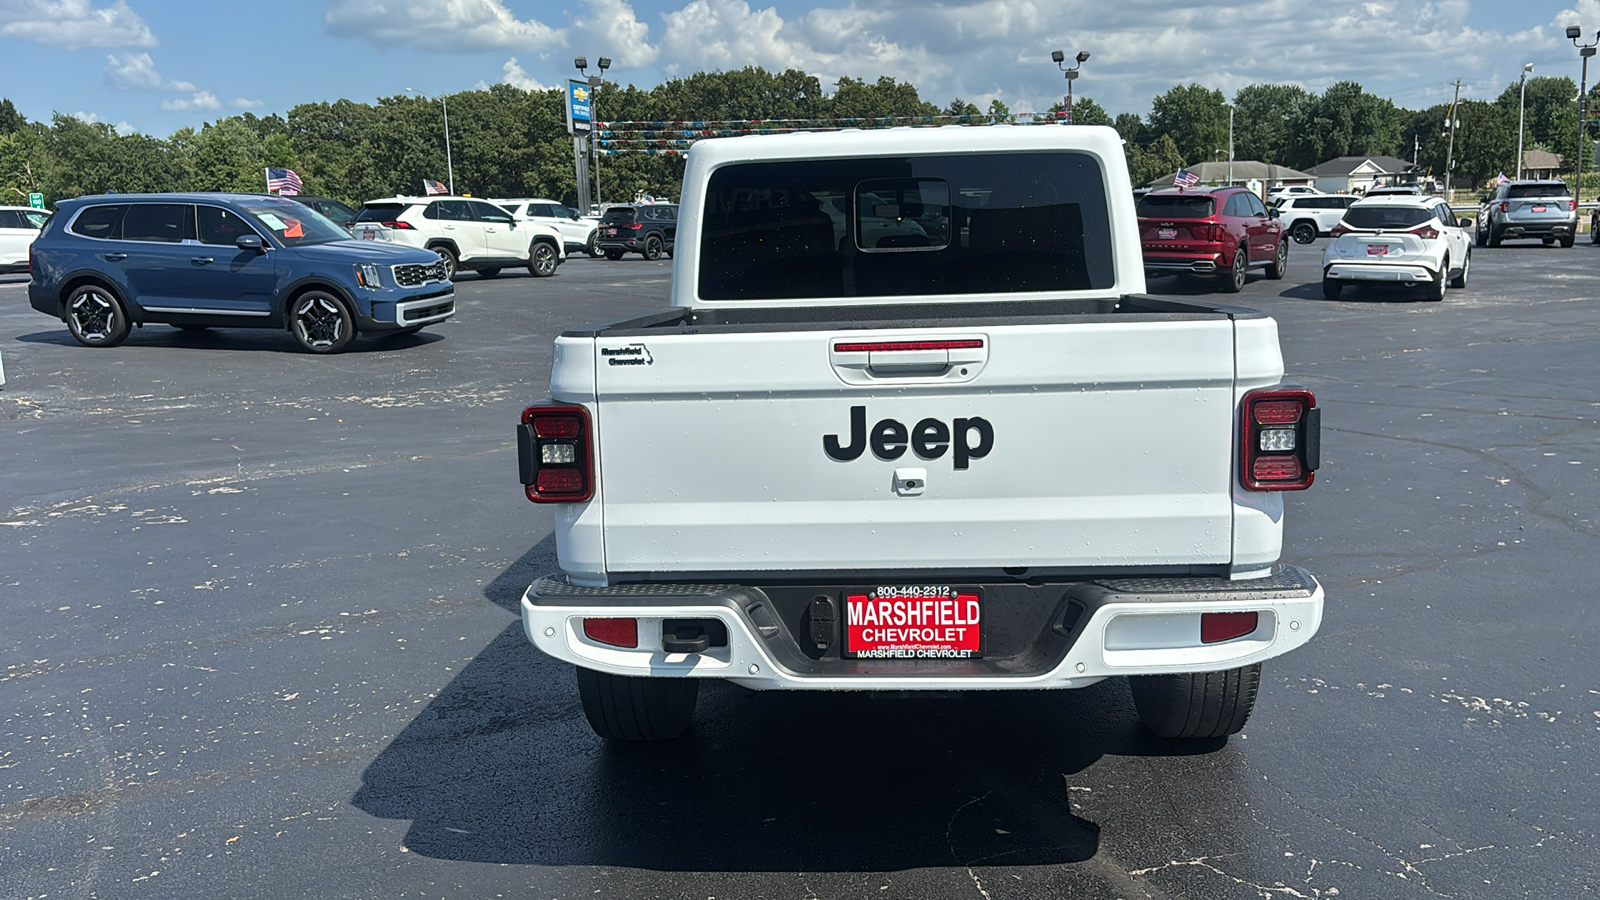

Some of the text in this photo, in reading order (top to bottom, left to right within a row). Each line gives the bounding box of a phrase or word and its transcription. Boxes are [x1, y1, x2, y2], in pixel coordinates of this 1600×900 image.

[601, 347, 642, 356] Marshfield
[608, 357, 646, 366] Chevrolet
[822, 405, 995, 471] Jeep
[876, 586, 950, 596] 800-440-2312
[847, 600, 981, 626] MARSHFIELD
[861, 628, 967, 642] CHEVROLET
[857, 649, 973, 658] MARSHFIELD CHEVROLET
